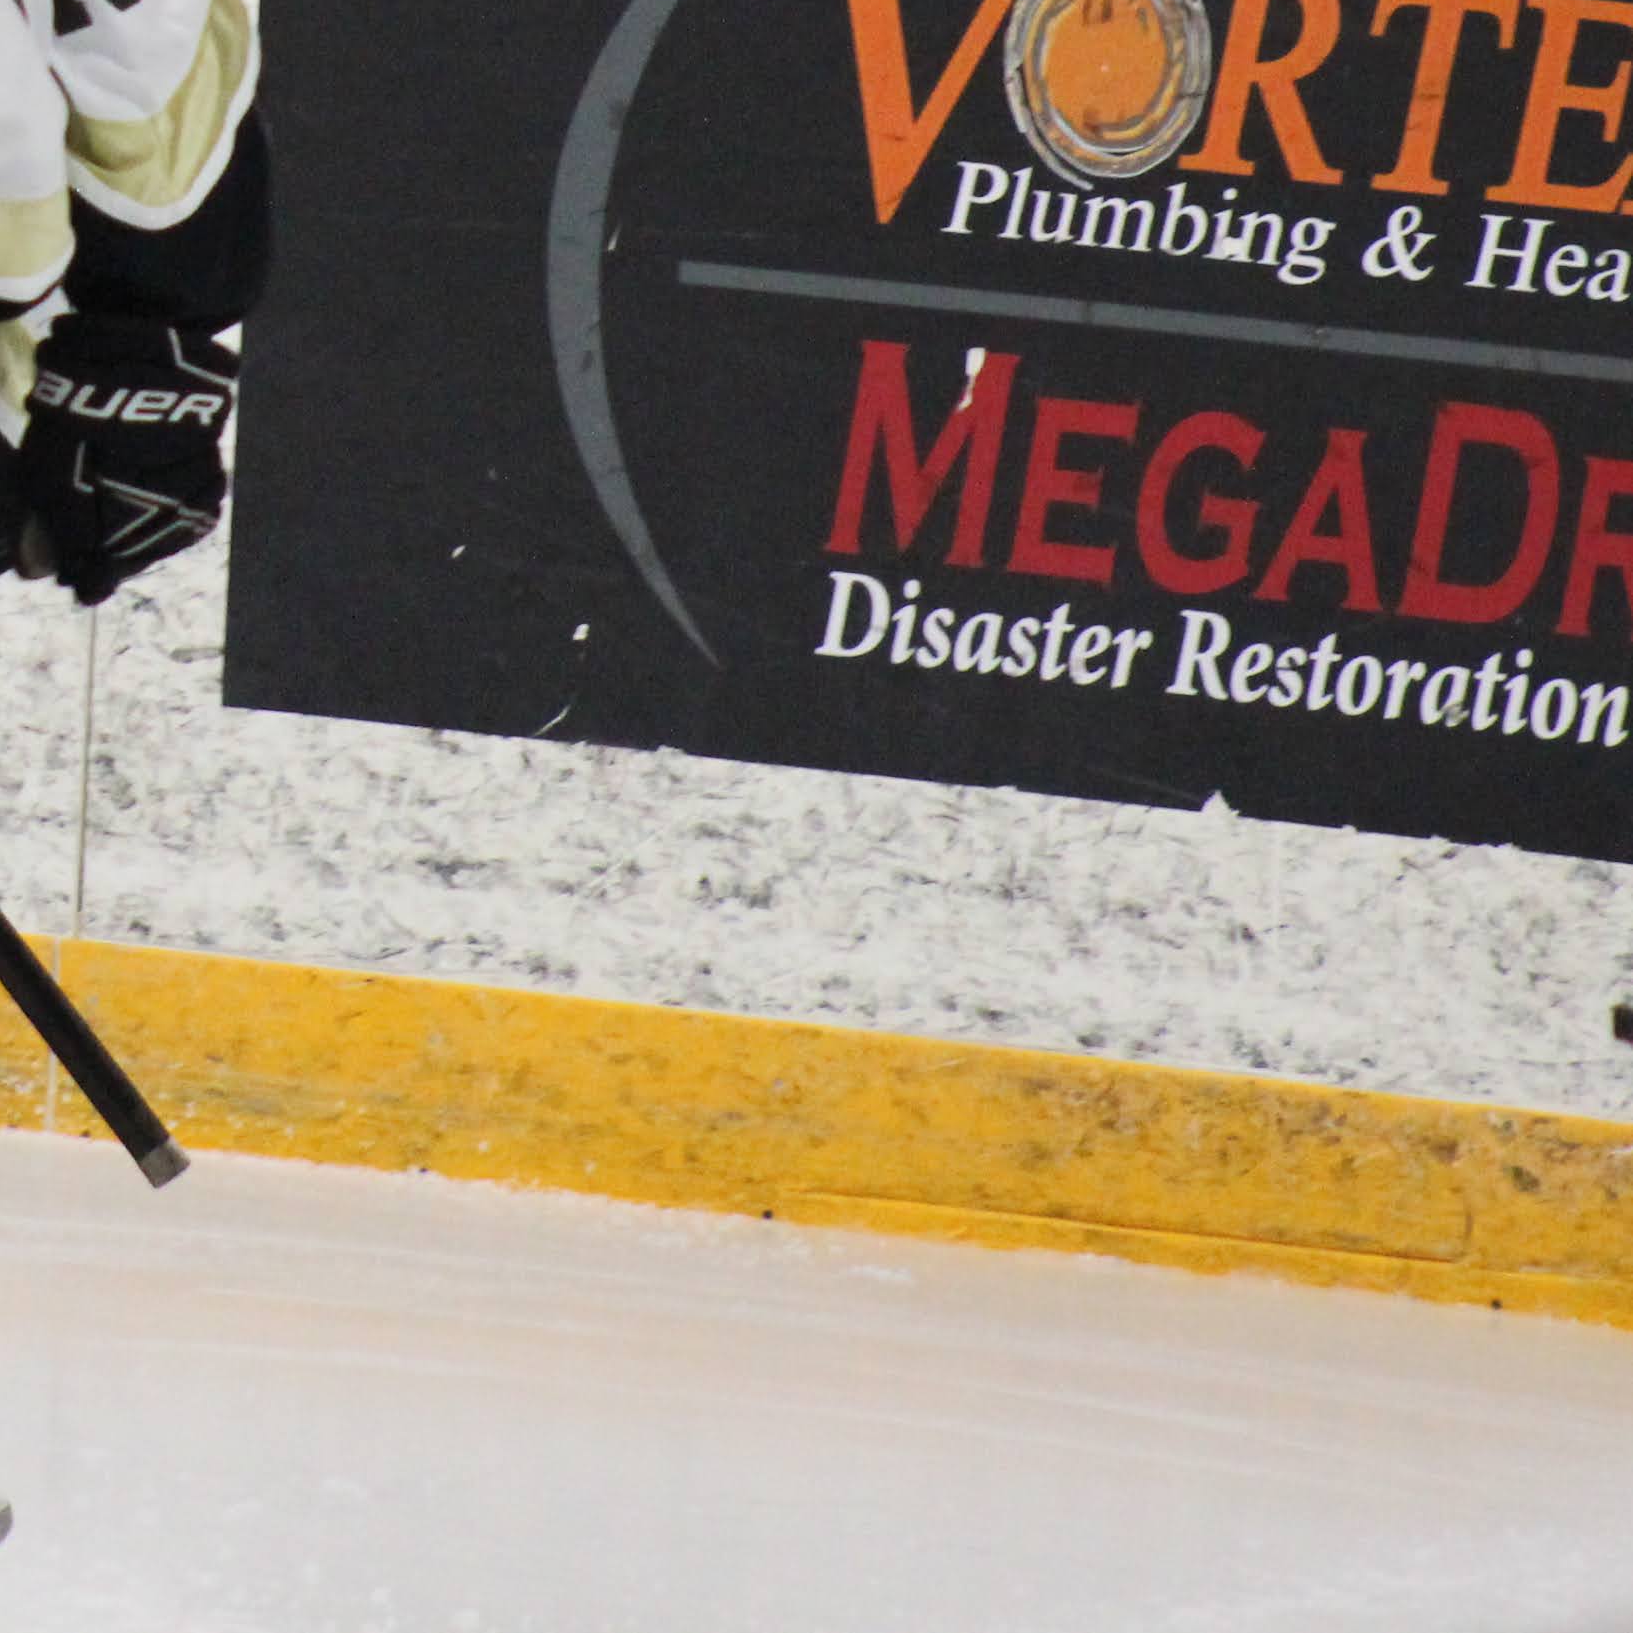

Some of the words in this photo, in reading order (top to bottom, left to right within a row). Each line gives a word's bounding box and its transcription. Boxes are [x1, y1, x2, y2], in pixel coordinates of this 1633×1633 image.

[941, 160, 1336, 285] Plumbing
[1361, 205, 1438, 282] &
[36, 369, 225, 427] AUER
[815, 570, 1153, 691] Disaster
[1164, 609, 1632, 750] Restoration
